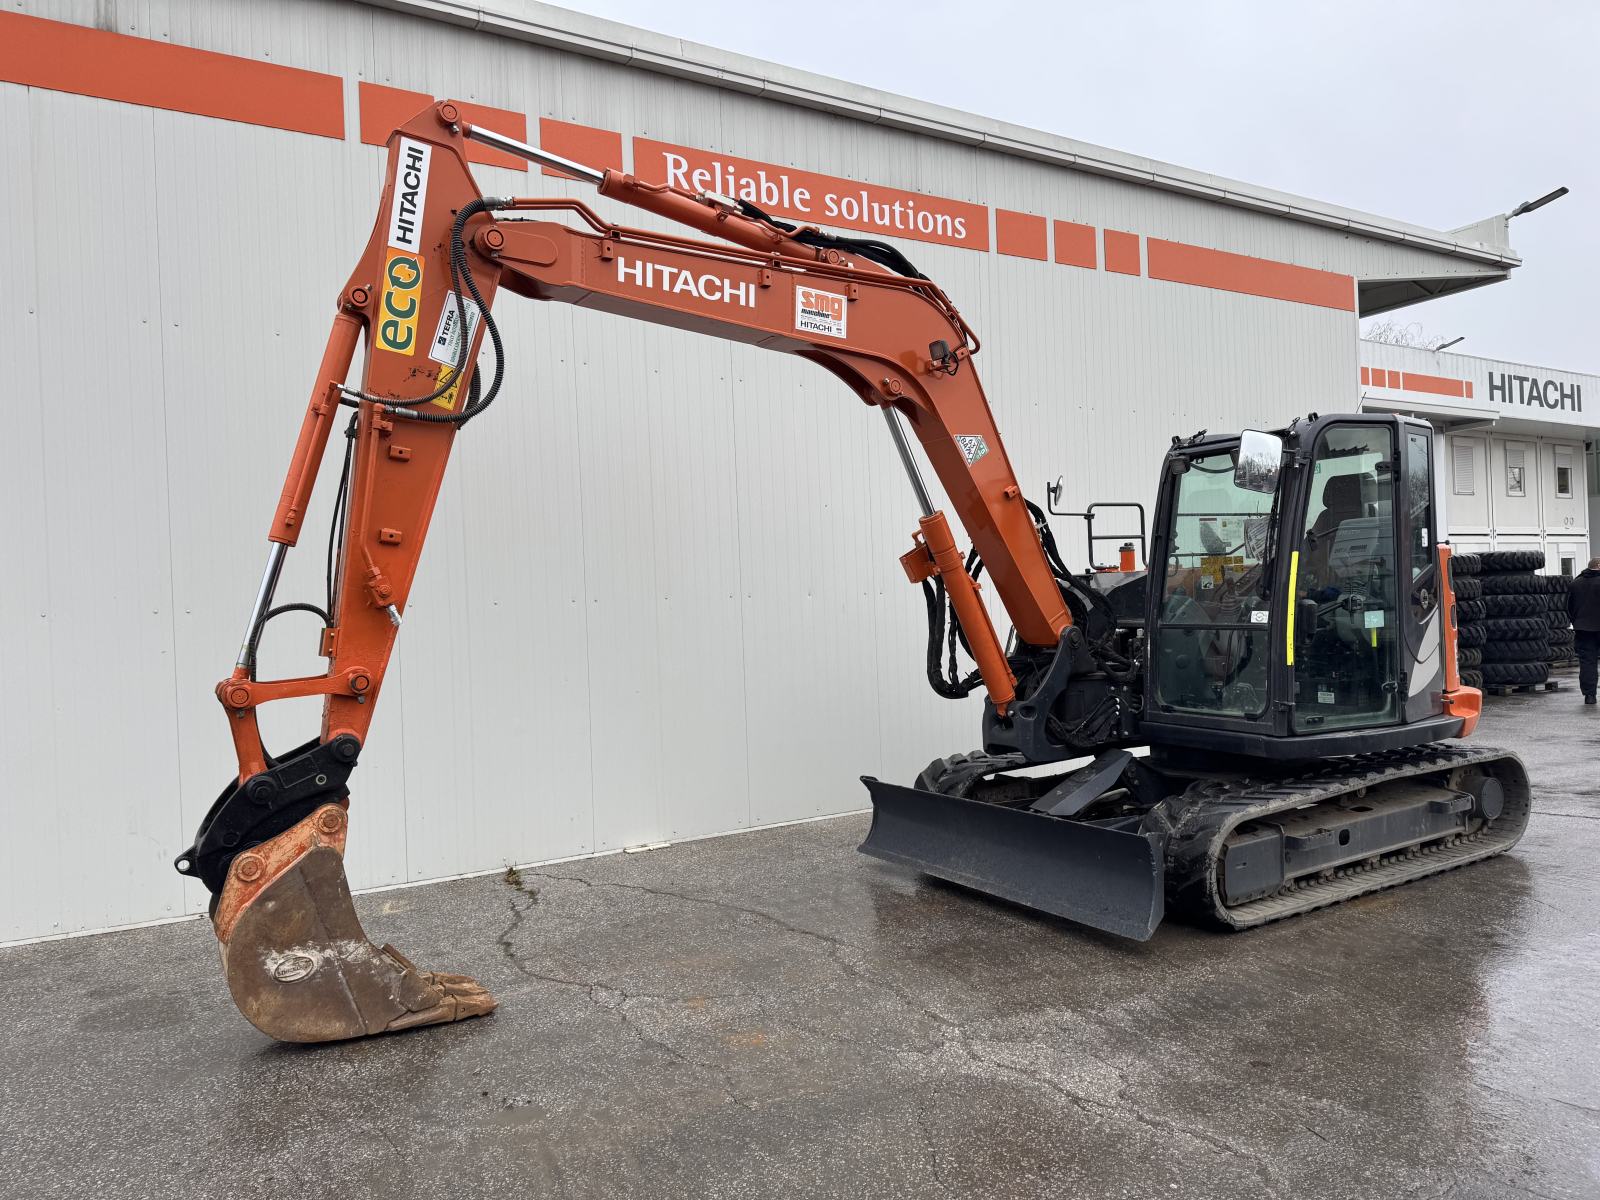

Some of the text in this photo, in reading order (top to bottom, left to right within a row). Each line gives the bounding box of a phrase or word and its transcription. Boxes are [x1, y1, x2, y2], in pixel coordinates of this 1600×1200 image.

[396, 146, 424, 244] HITACHI
[662, 152, 966, 239] Reliable solutions
[617, 257, 756, 308] HITACHI
[442, 310, 455, 336] TEFRA
[801, 321, 832, 332] HITACHI
[1488, 371, 1583, 412] HITACHI
